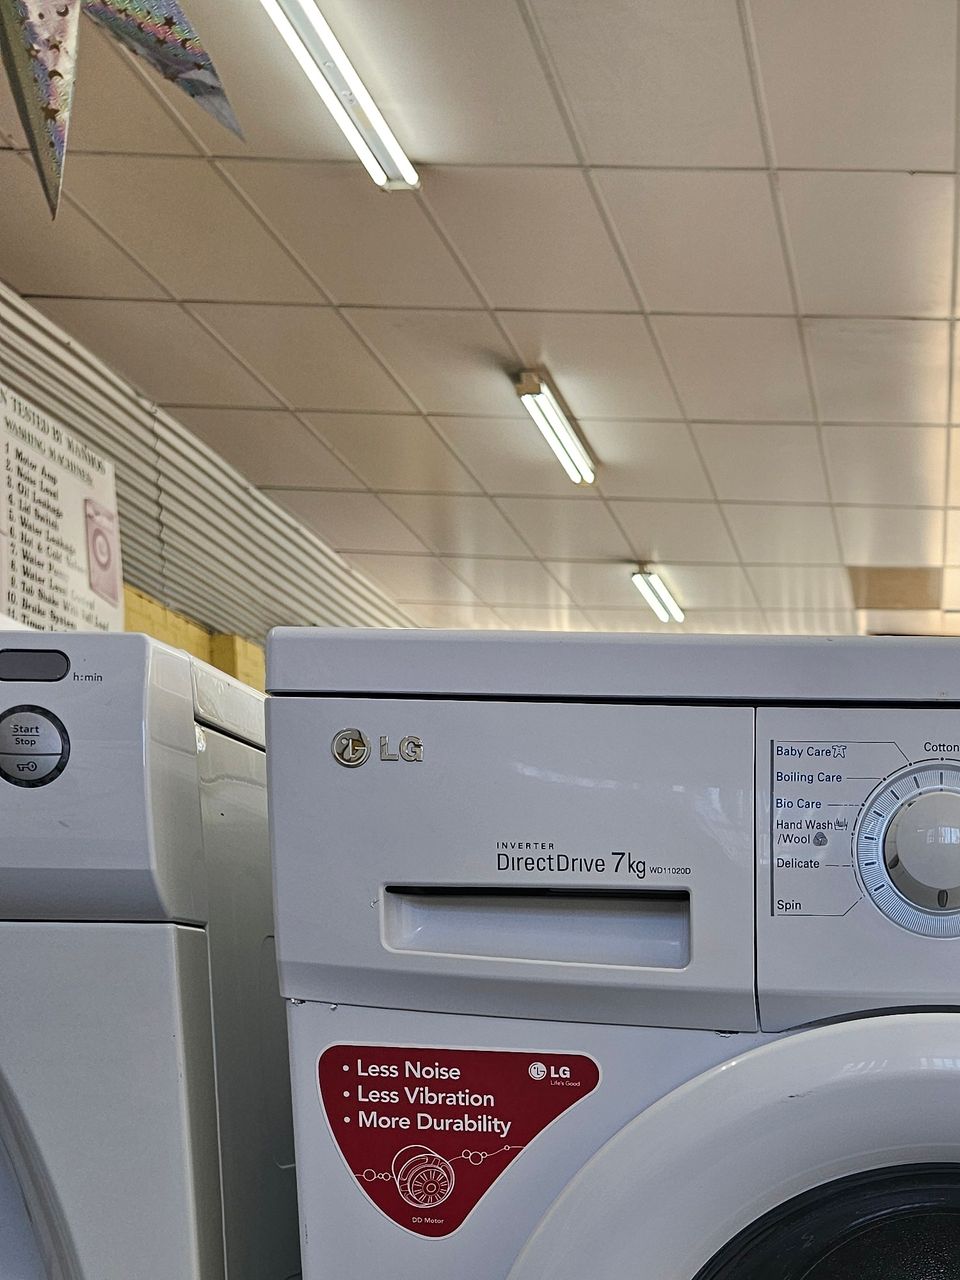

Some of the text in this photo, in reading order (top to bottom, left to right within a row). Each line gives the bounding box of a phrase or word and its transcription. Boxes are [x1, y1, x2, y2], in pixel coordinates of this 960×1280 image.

[73, 673, 102, 681] h:min
[13, 725, 39, 733] Start
[15, 738, 36, 746] Stop
[924, 742, 959, 752] Cotton
[379, 736, 423, 761] LG
[777, 746, 831, 756] Baby Care
[777, 772, 842, 783] Boiling Care
[776, 799, 821, 808] Bio Care
[777, 820, 833, 829] Hand Wash
[778, 834, 810, 844] /Wool
[777, 859, 819, 868] Delicate
[650, 867, 691, 875] WD11020D
[777, 900, 801, 911] Spin
[357, 1060, 460, 1079] Less Noise
[551, 1067, 570, 1078] LG
[357, 1086, 494, 1106] Less Vibration
[358, 1111, 512, 1137] More Durability
